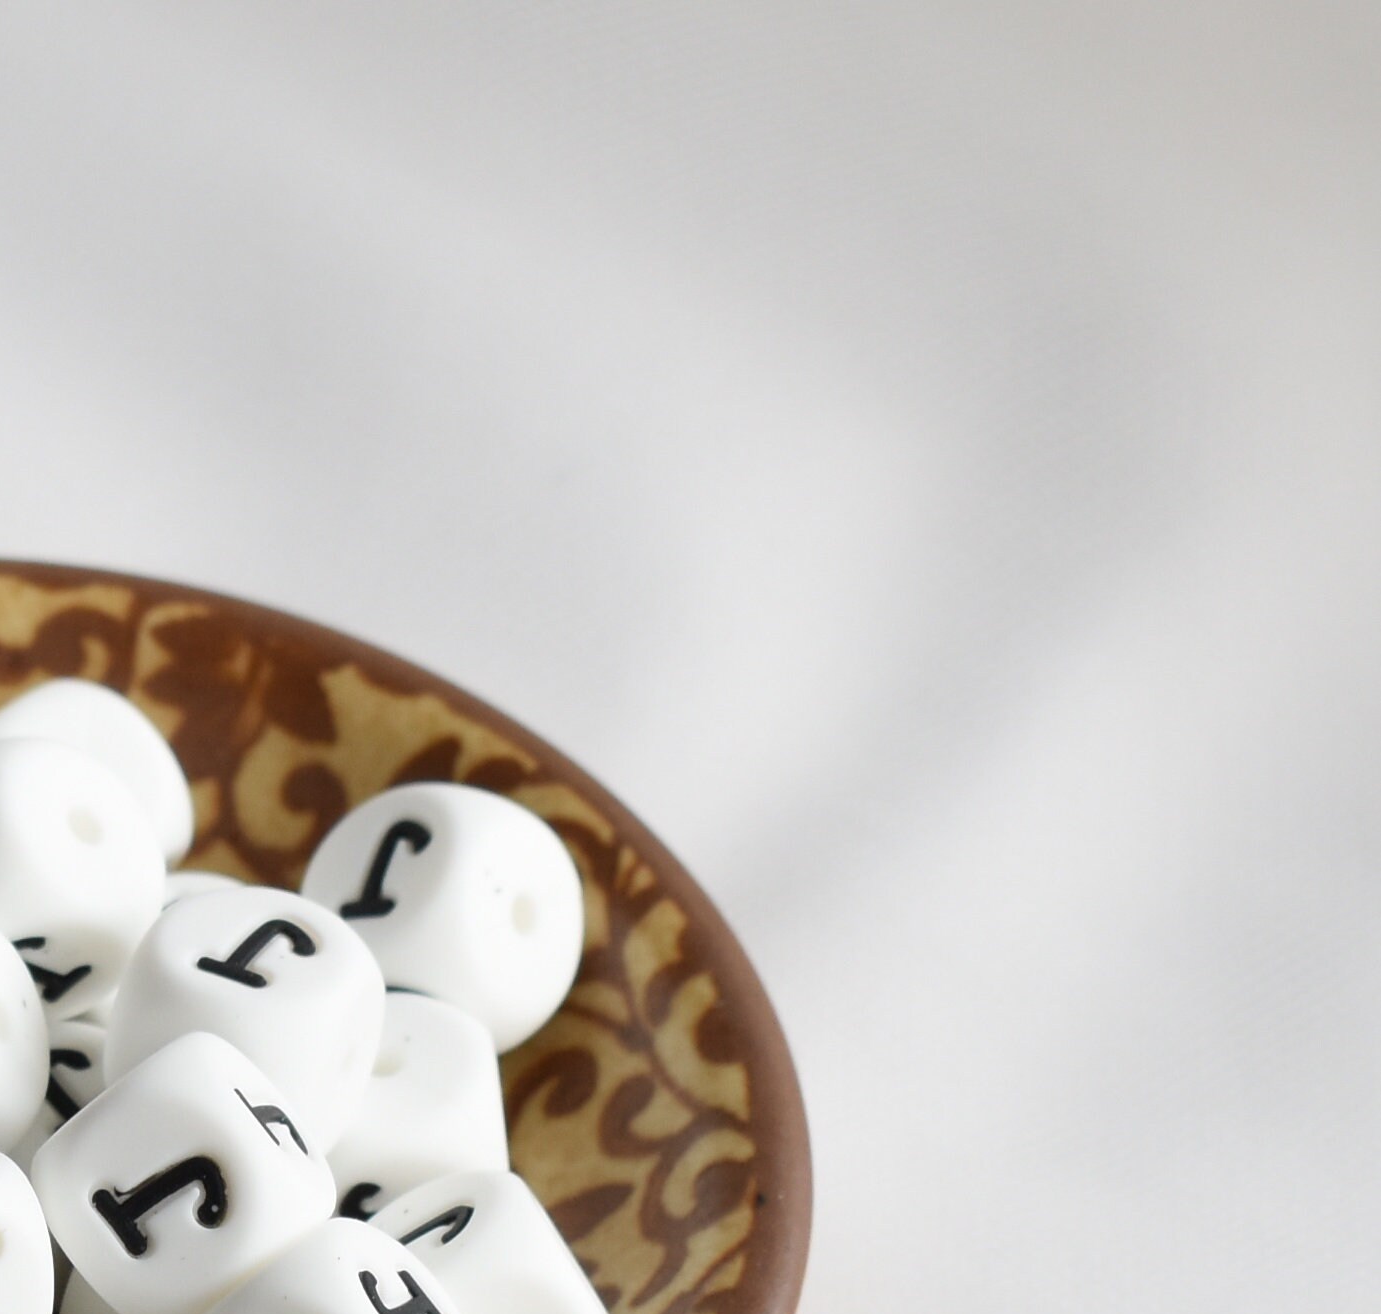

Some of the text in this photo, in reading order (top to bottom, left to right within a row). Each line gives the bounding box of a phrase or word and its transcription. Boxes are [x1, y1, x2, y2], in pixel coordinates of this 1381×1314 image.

[339, 819, 432, 919] J
[196, 918, 316, 989] J
[234, 1088, 308, 1156] J
[90, 1154, 229, 1258] J
